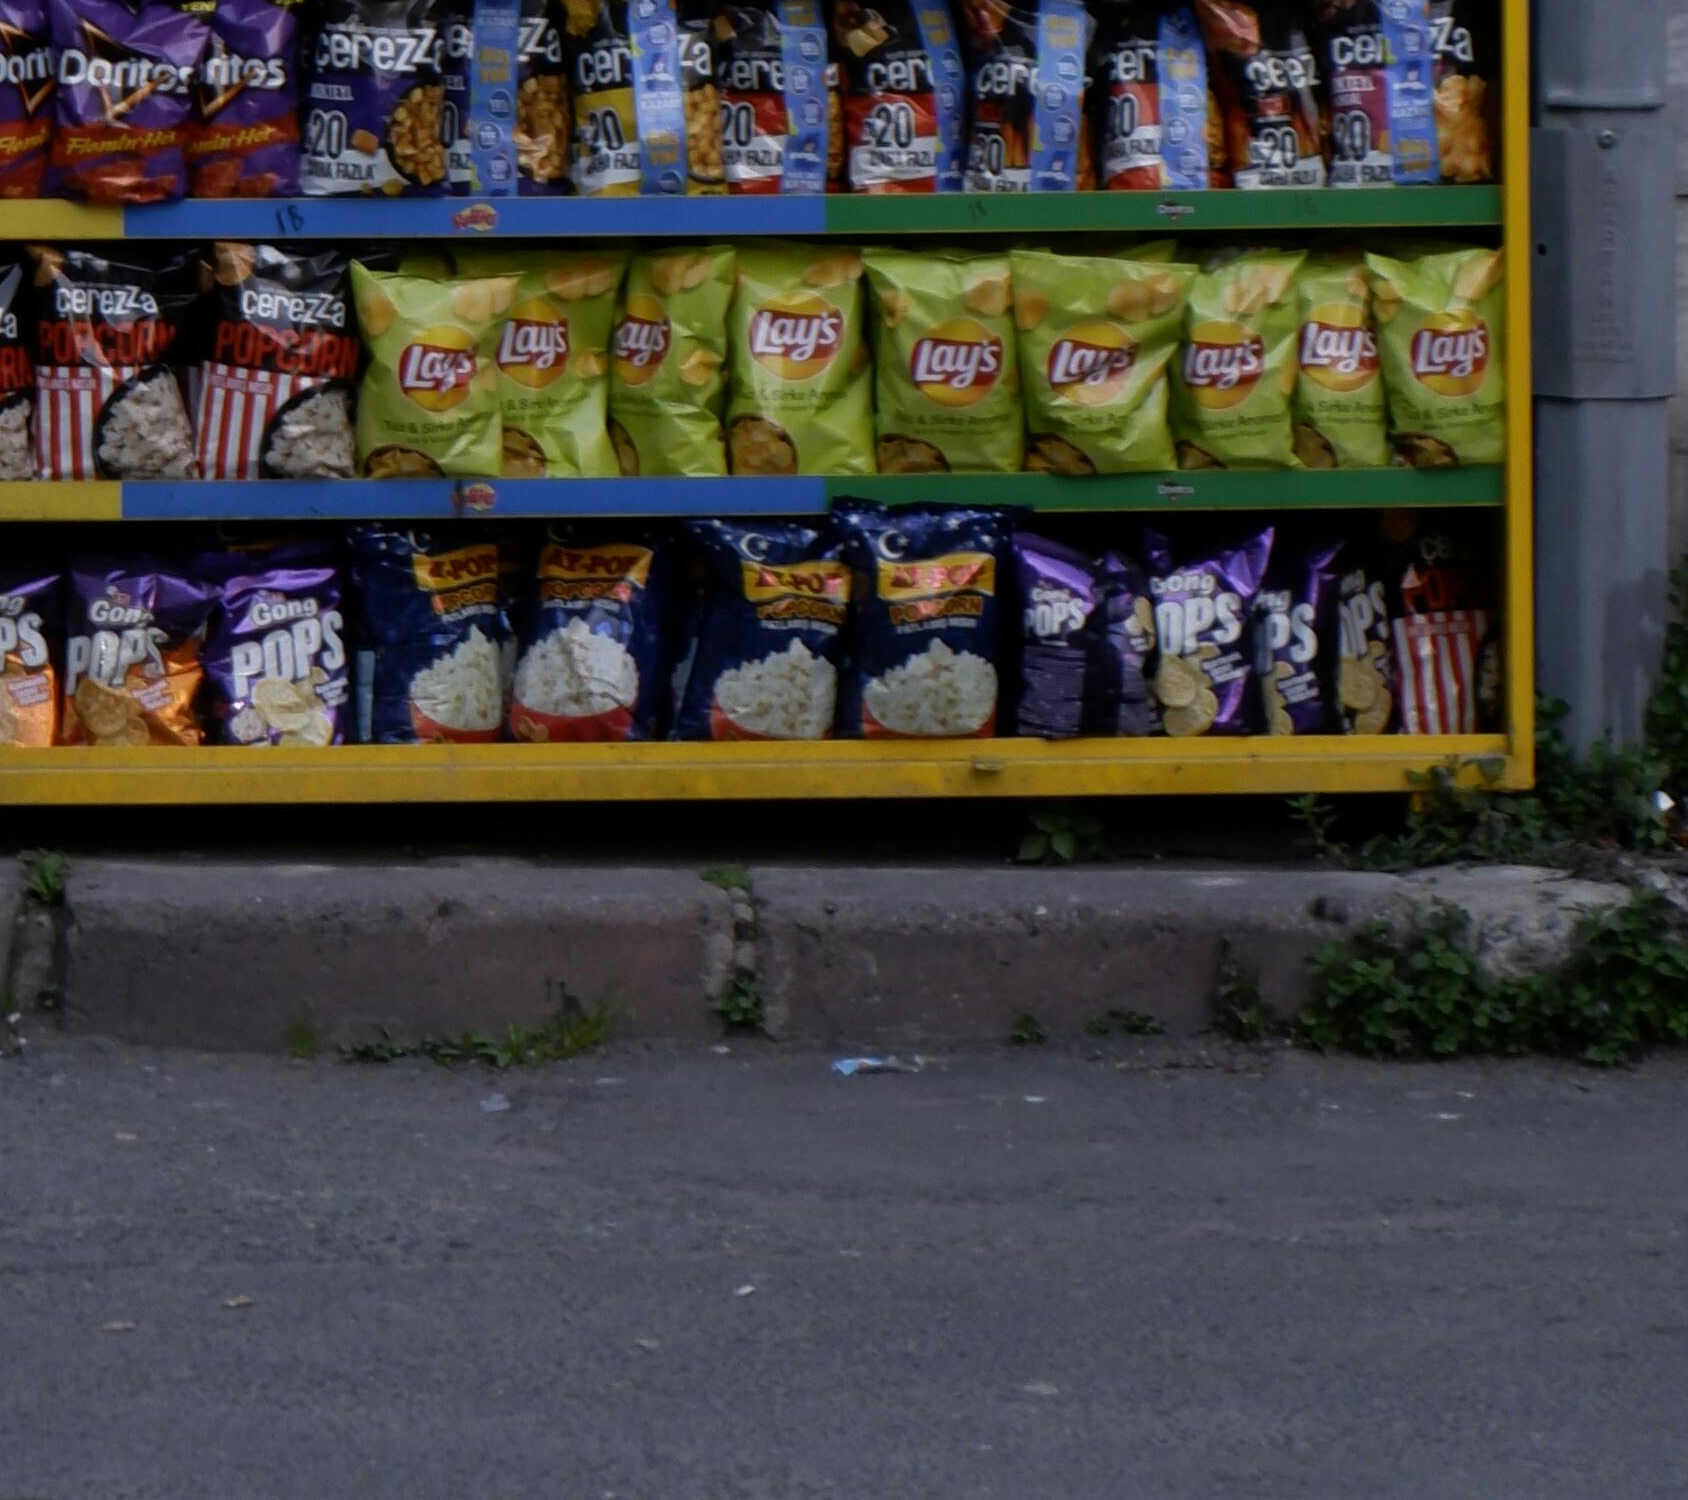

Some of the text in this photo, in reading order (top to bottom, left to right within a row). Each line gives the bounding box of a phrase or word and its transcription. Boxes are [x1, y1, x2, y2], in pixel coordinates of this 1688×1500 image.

[59, 51, 193, 93] Doritos
[336, 163, 374, 181] FAZLA
[39, 319, 178, 366] POPCORN
[215, 322, 360, 376] POPCORN
[499, 319, 568, 368] Lay's
[753, 310, 840, 362] Lay's
[1301, 320, 1377, 370] Lay's
[1415, 328, 1487, 376] Lay's
[405, 345, 477, 391] Lay's
[914, 339, 1002, 389] Lay's
[251, 598, 318, 628] Gong
[1157, 597, 1243, 655] OPS
[68, 628, 169, 697] POPS
[232, 610, 345, 700] POPS
